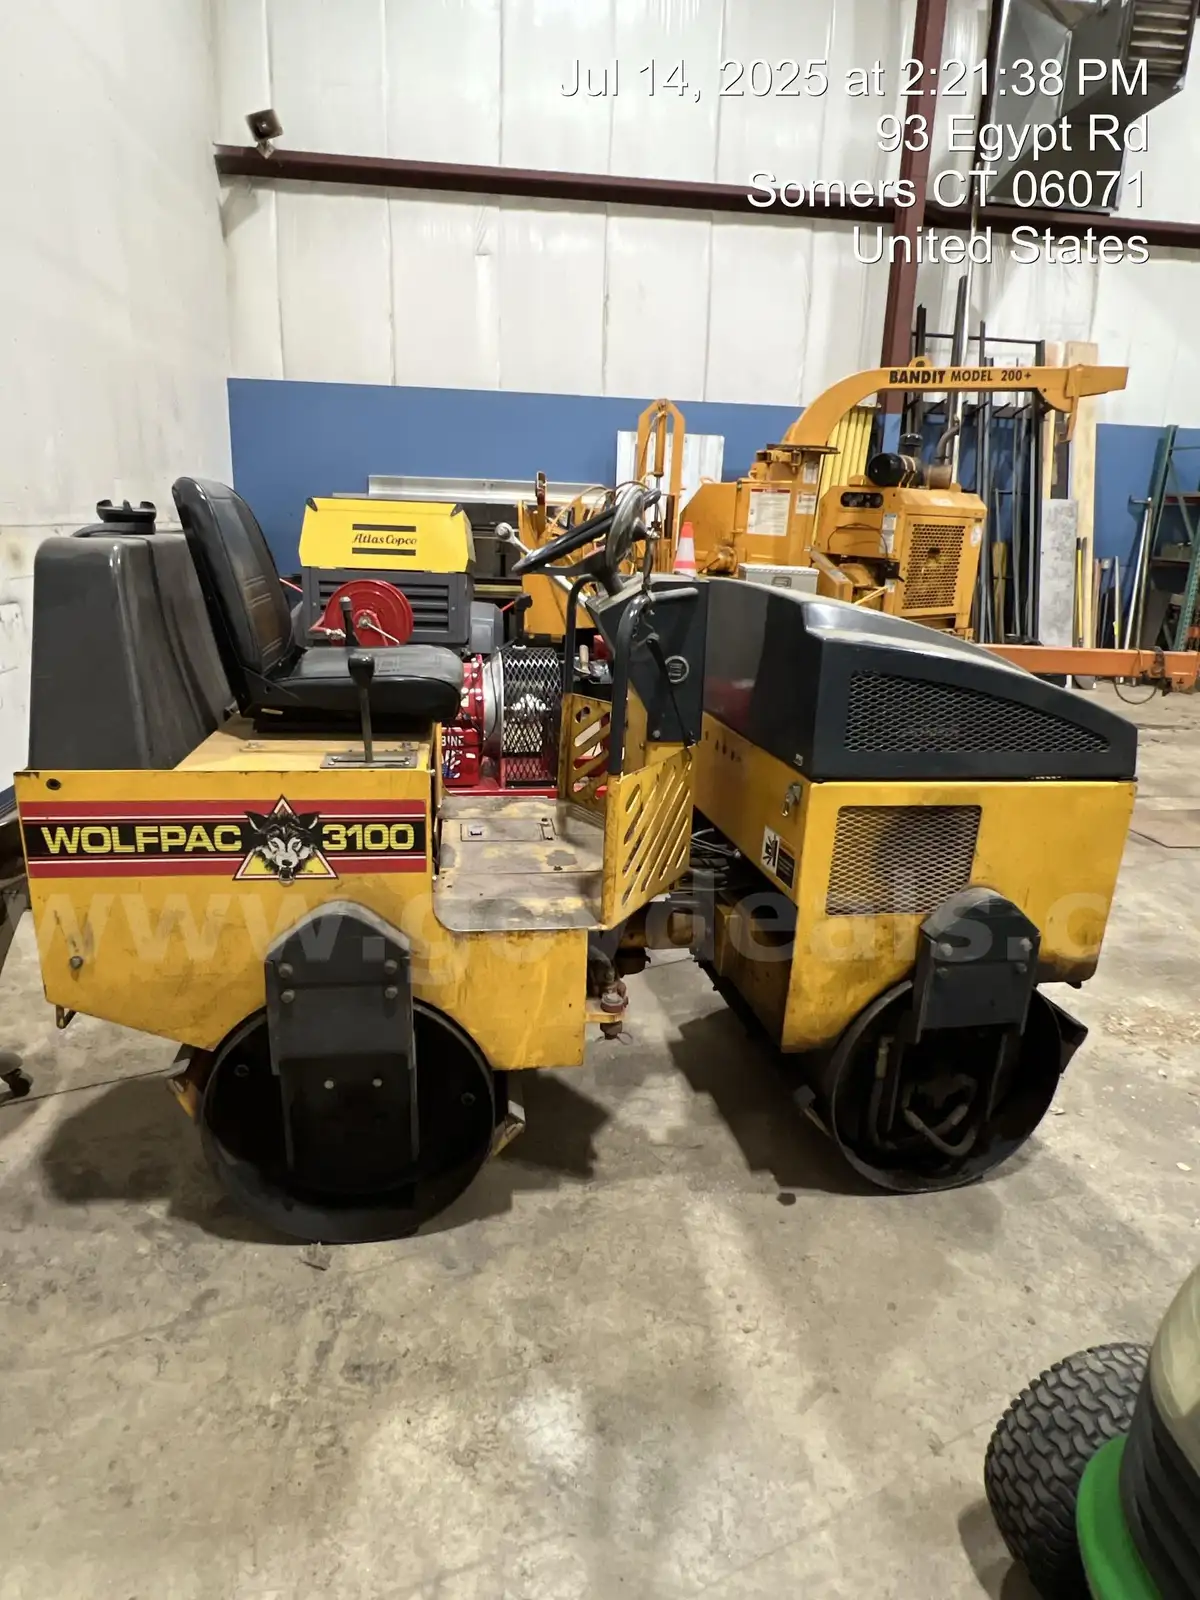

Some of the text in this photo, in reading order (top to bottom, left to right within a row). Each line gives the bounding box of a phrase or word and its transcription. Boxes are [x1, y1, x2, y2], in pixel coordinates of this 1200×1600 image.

[889, 370, 946, 384] BANDIT
[950, 370, 993, 383] MODEL
[352, 533, 417, 546] Atlas Copco
[40, 823, 415, 854] WOLFPAC 3100
